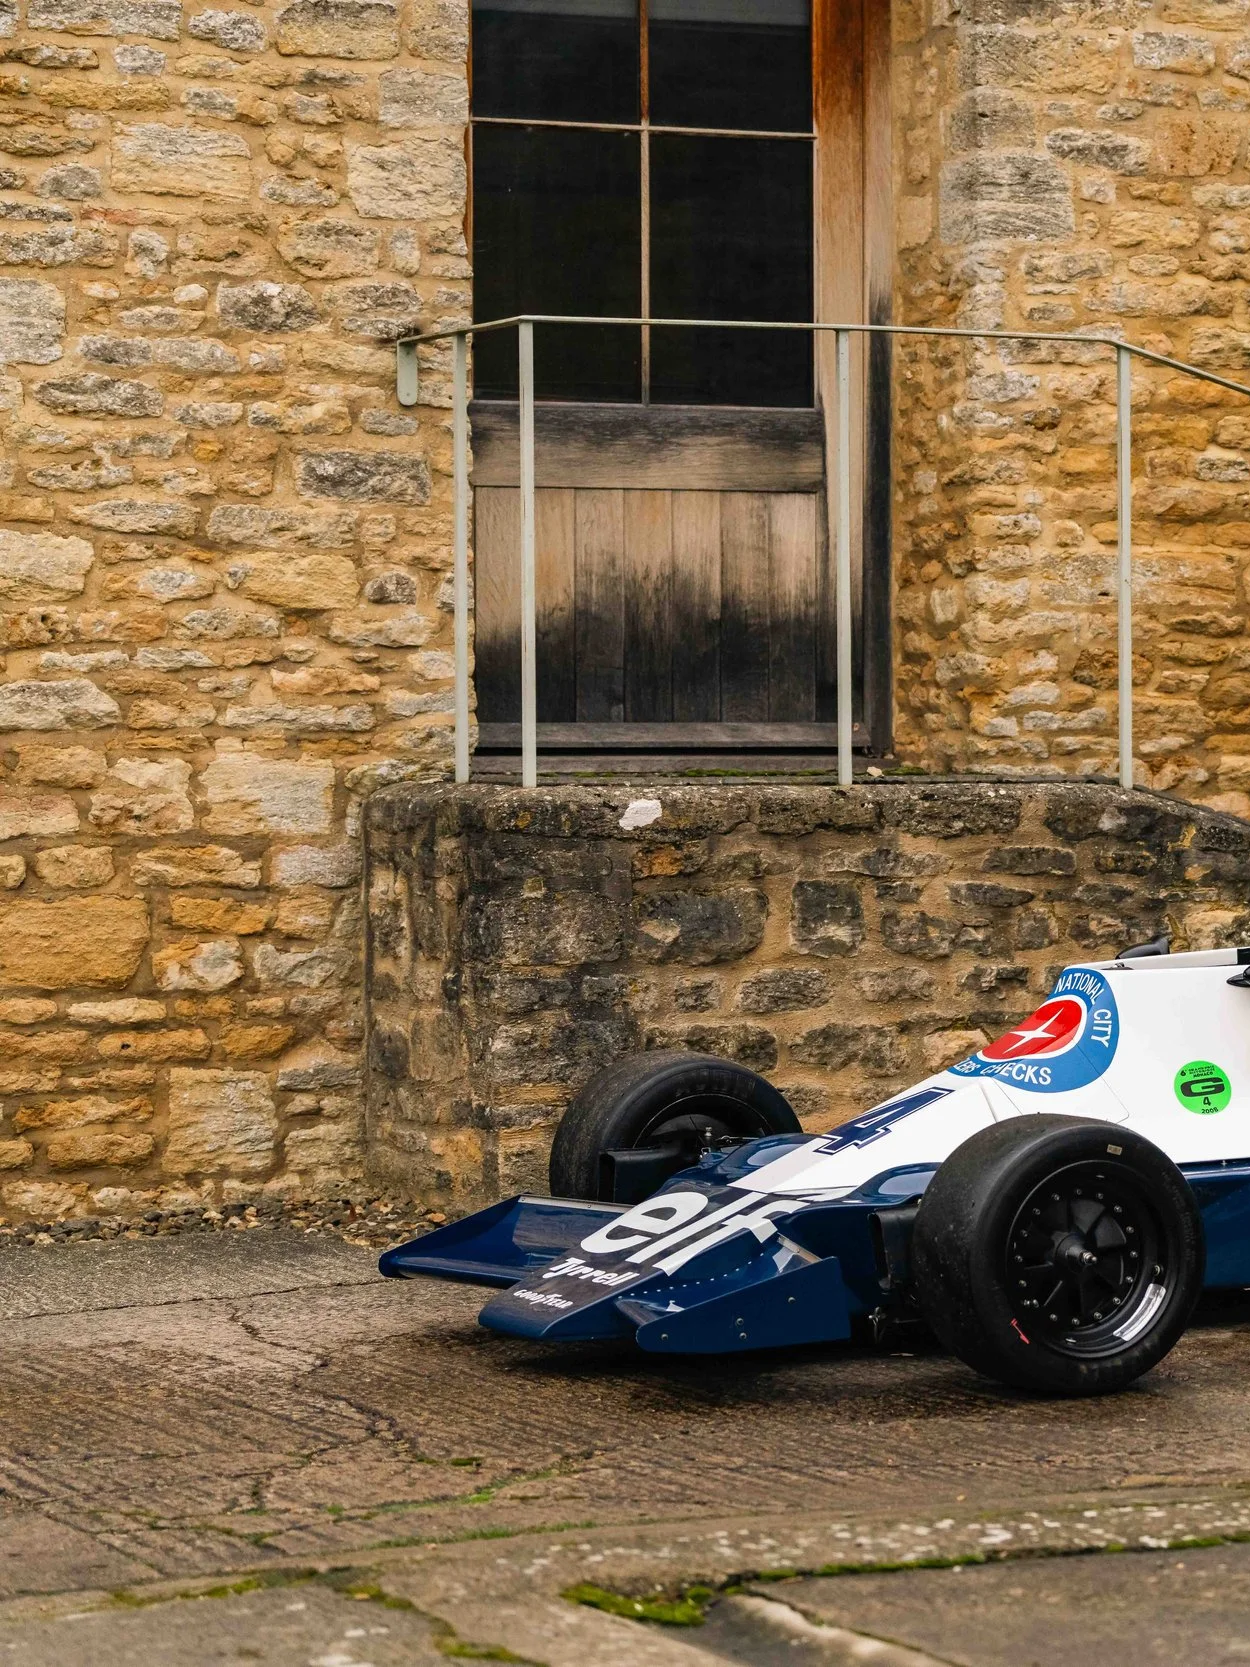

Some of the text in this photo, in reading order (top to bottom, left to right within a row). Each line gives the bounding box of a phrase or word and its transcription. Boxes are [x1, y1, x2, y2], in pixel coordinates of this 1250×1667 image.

[1054, 972, 1112, 1048] NATIONAL CITY
[980, 1062, 1052, 1086] CHECKS
[1180, 1077, 1225, 1097] G
[1203, 1096, 1212, 1106] 4
[813, 1086, 956, 1155] 4
[580, 1191, 811, 1277] elf
[542, 1257, 641, 1286] Tyrrell
